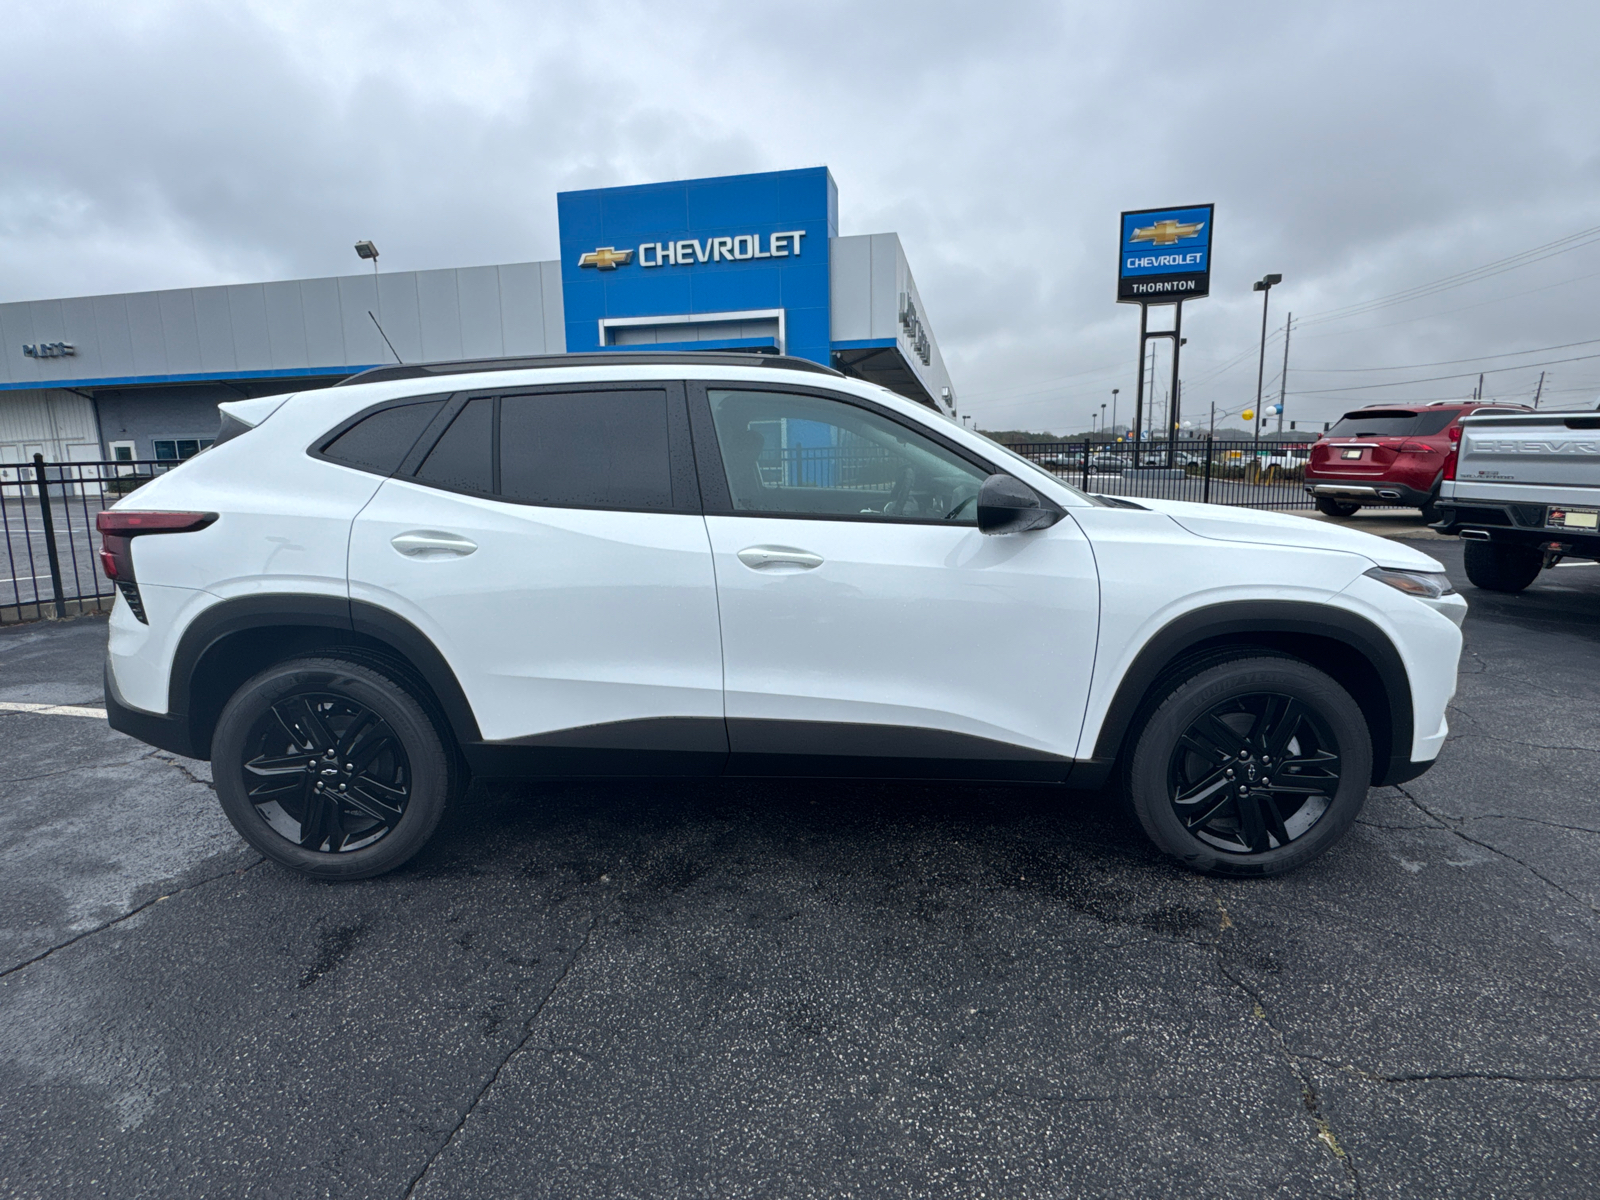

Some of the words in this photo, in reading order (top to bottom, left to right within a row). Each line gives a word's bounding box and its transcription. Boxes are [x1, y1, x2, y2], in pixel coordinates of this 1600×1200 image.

[639, 230, 806, 267] CHEVROLET
[1126, 252, 1202, 268] CHEVROLET
[1132, 280, 1195, 293] THORNTON
